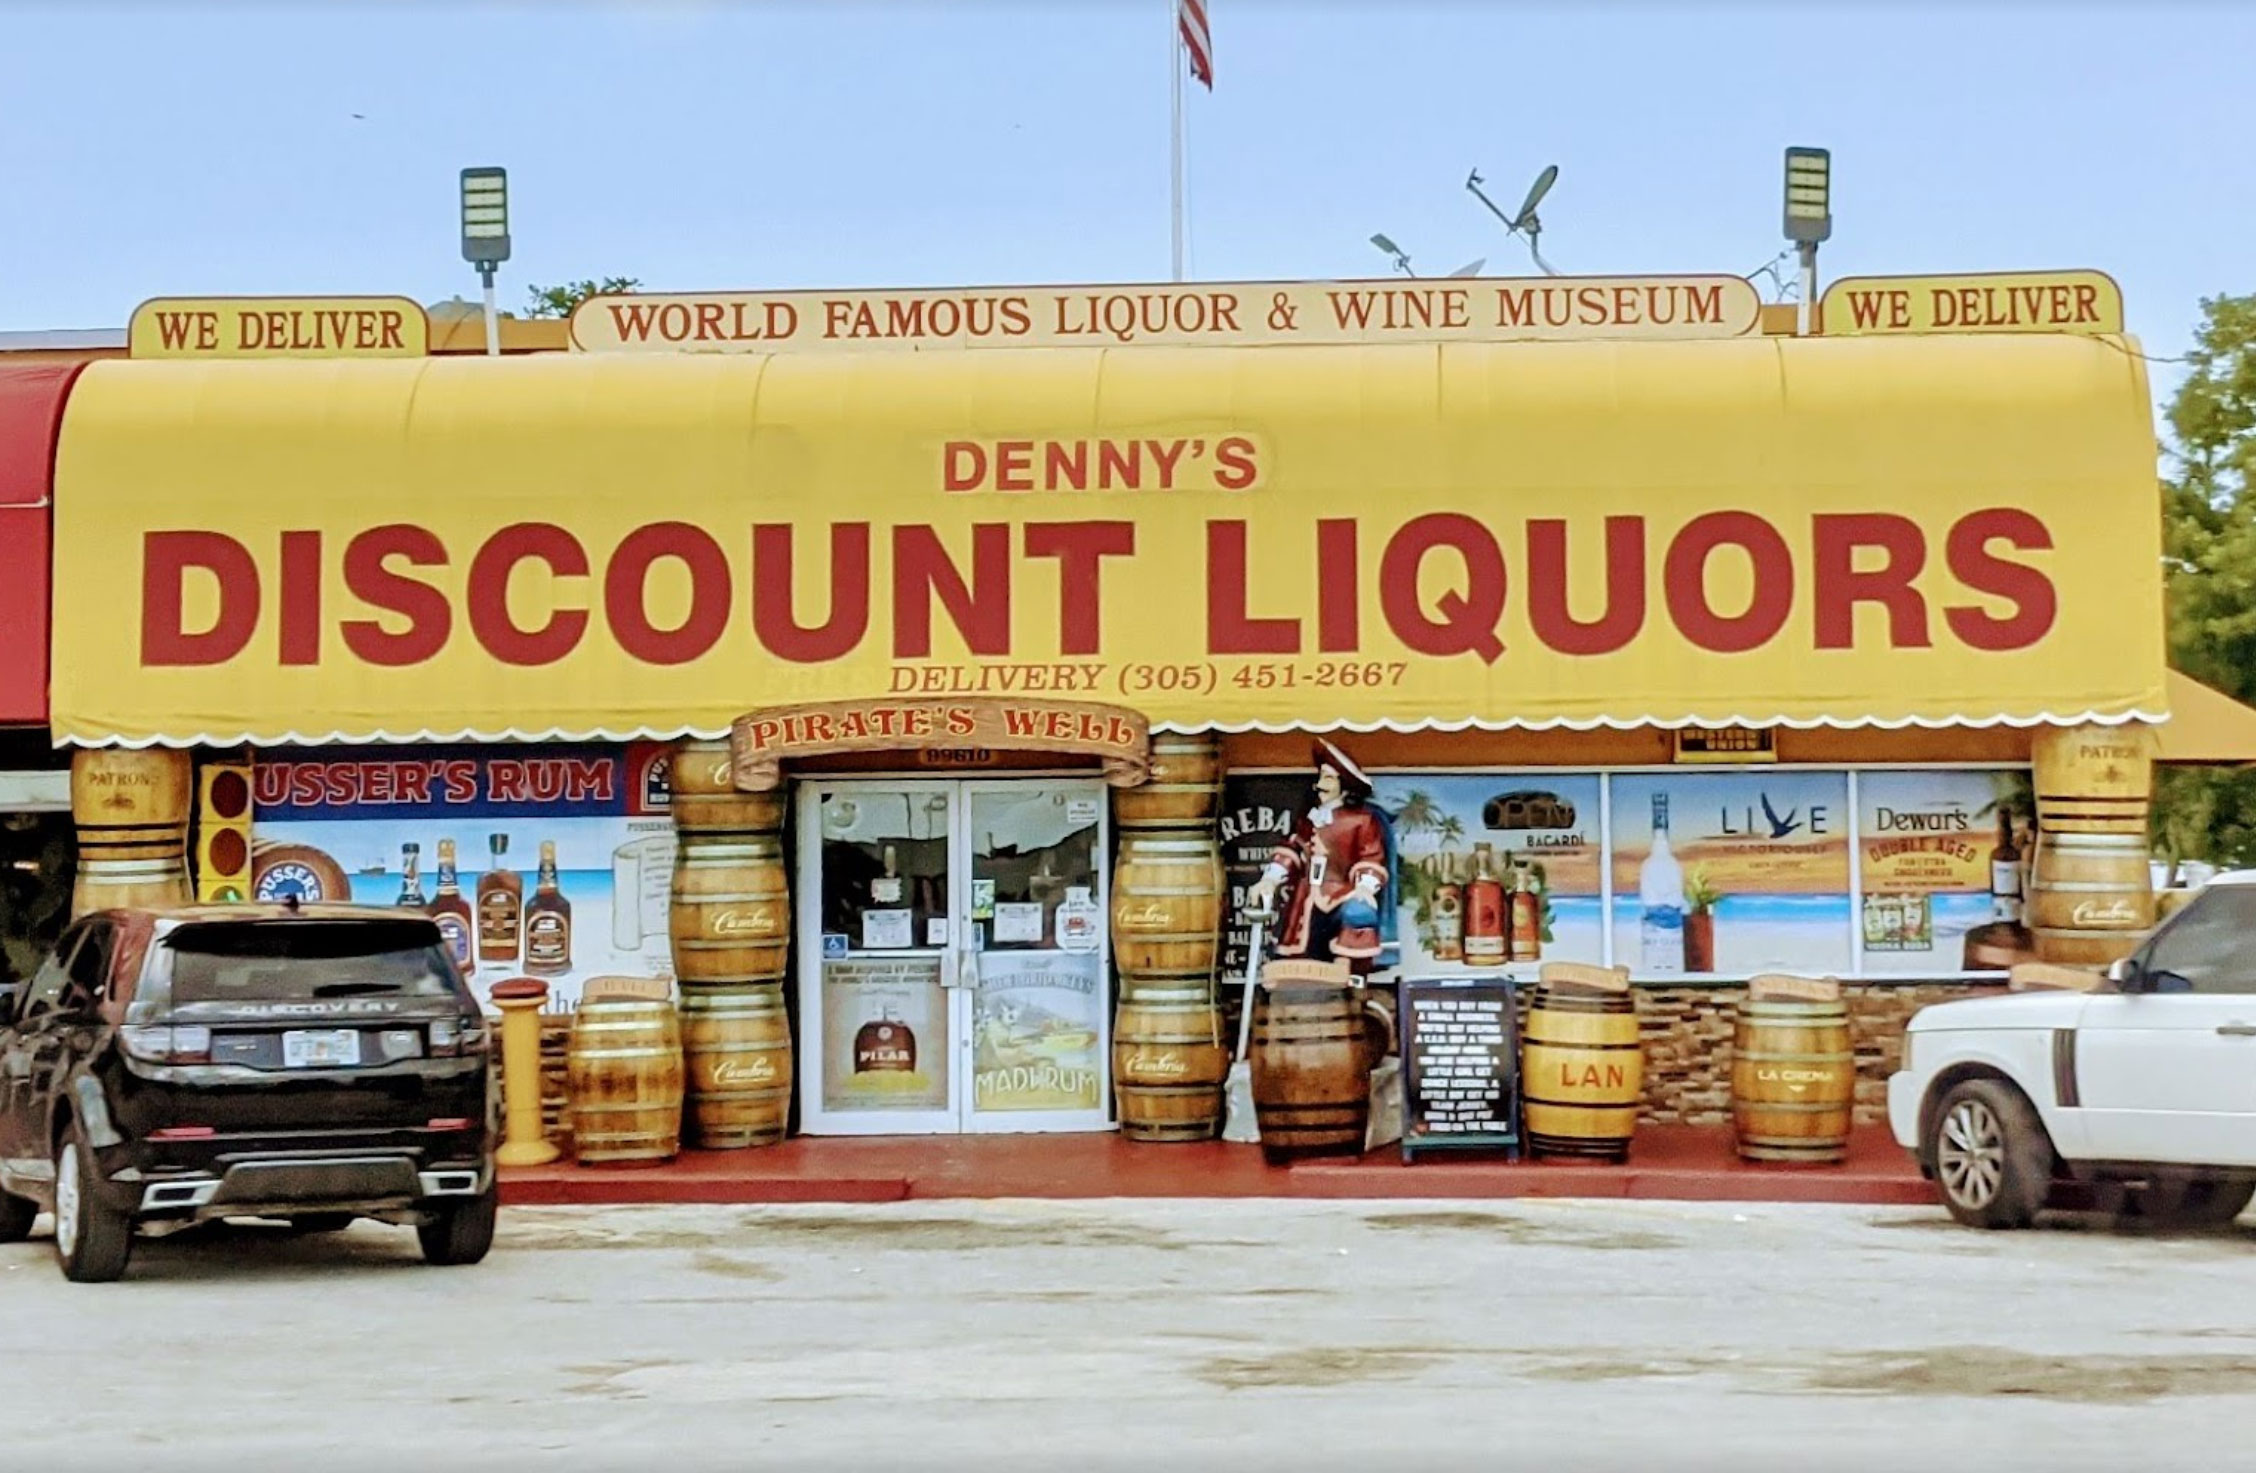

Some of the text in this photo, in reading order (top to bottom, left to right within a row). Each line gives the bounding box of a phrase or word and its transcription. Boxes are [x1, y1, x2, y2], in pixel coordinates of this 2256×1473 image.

[607, 284, 1725, 342] WORLD FAMOUS LIQUOR & WINE MUSEUM
[1846, 284, 2100, 329] WE DELIVER
[155, 310, 406, 350] WE DELIVER
[944, 437, 1257, 491] DENNY'S
[140, 506, 2058, 667] DISCOUNT LIQUORS
[888, 661, 1409, 696] DELIVERY (305) 451-2667
[751, 704, 1137, 752] PIRATE'S WELL
[253, 758, 614, 806] USSER'S RUM
[1876, 807, 1969, 832] Dewar's
[1936, 838, 1978, 863] AGED
[240, 1002, 399, 1014] DISCOVERY
[859, 1050, 911, 1063] PILAR
[1560, 1063, 1624, 1089] LAN
